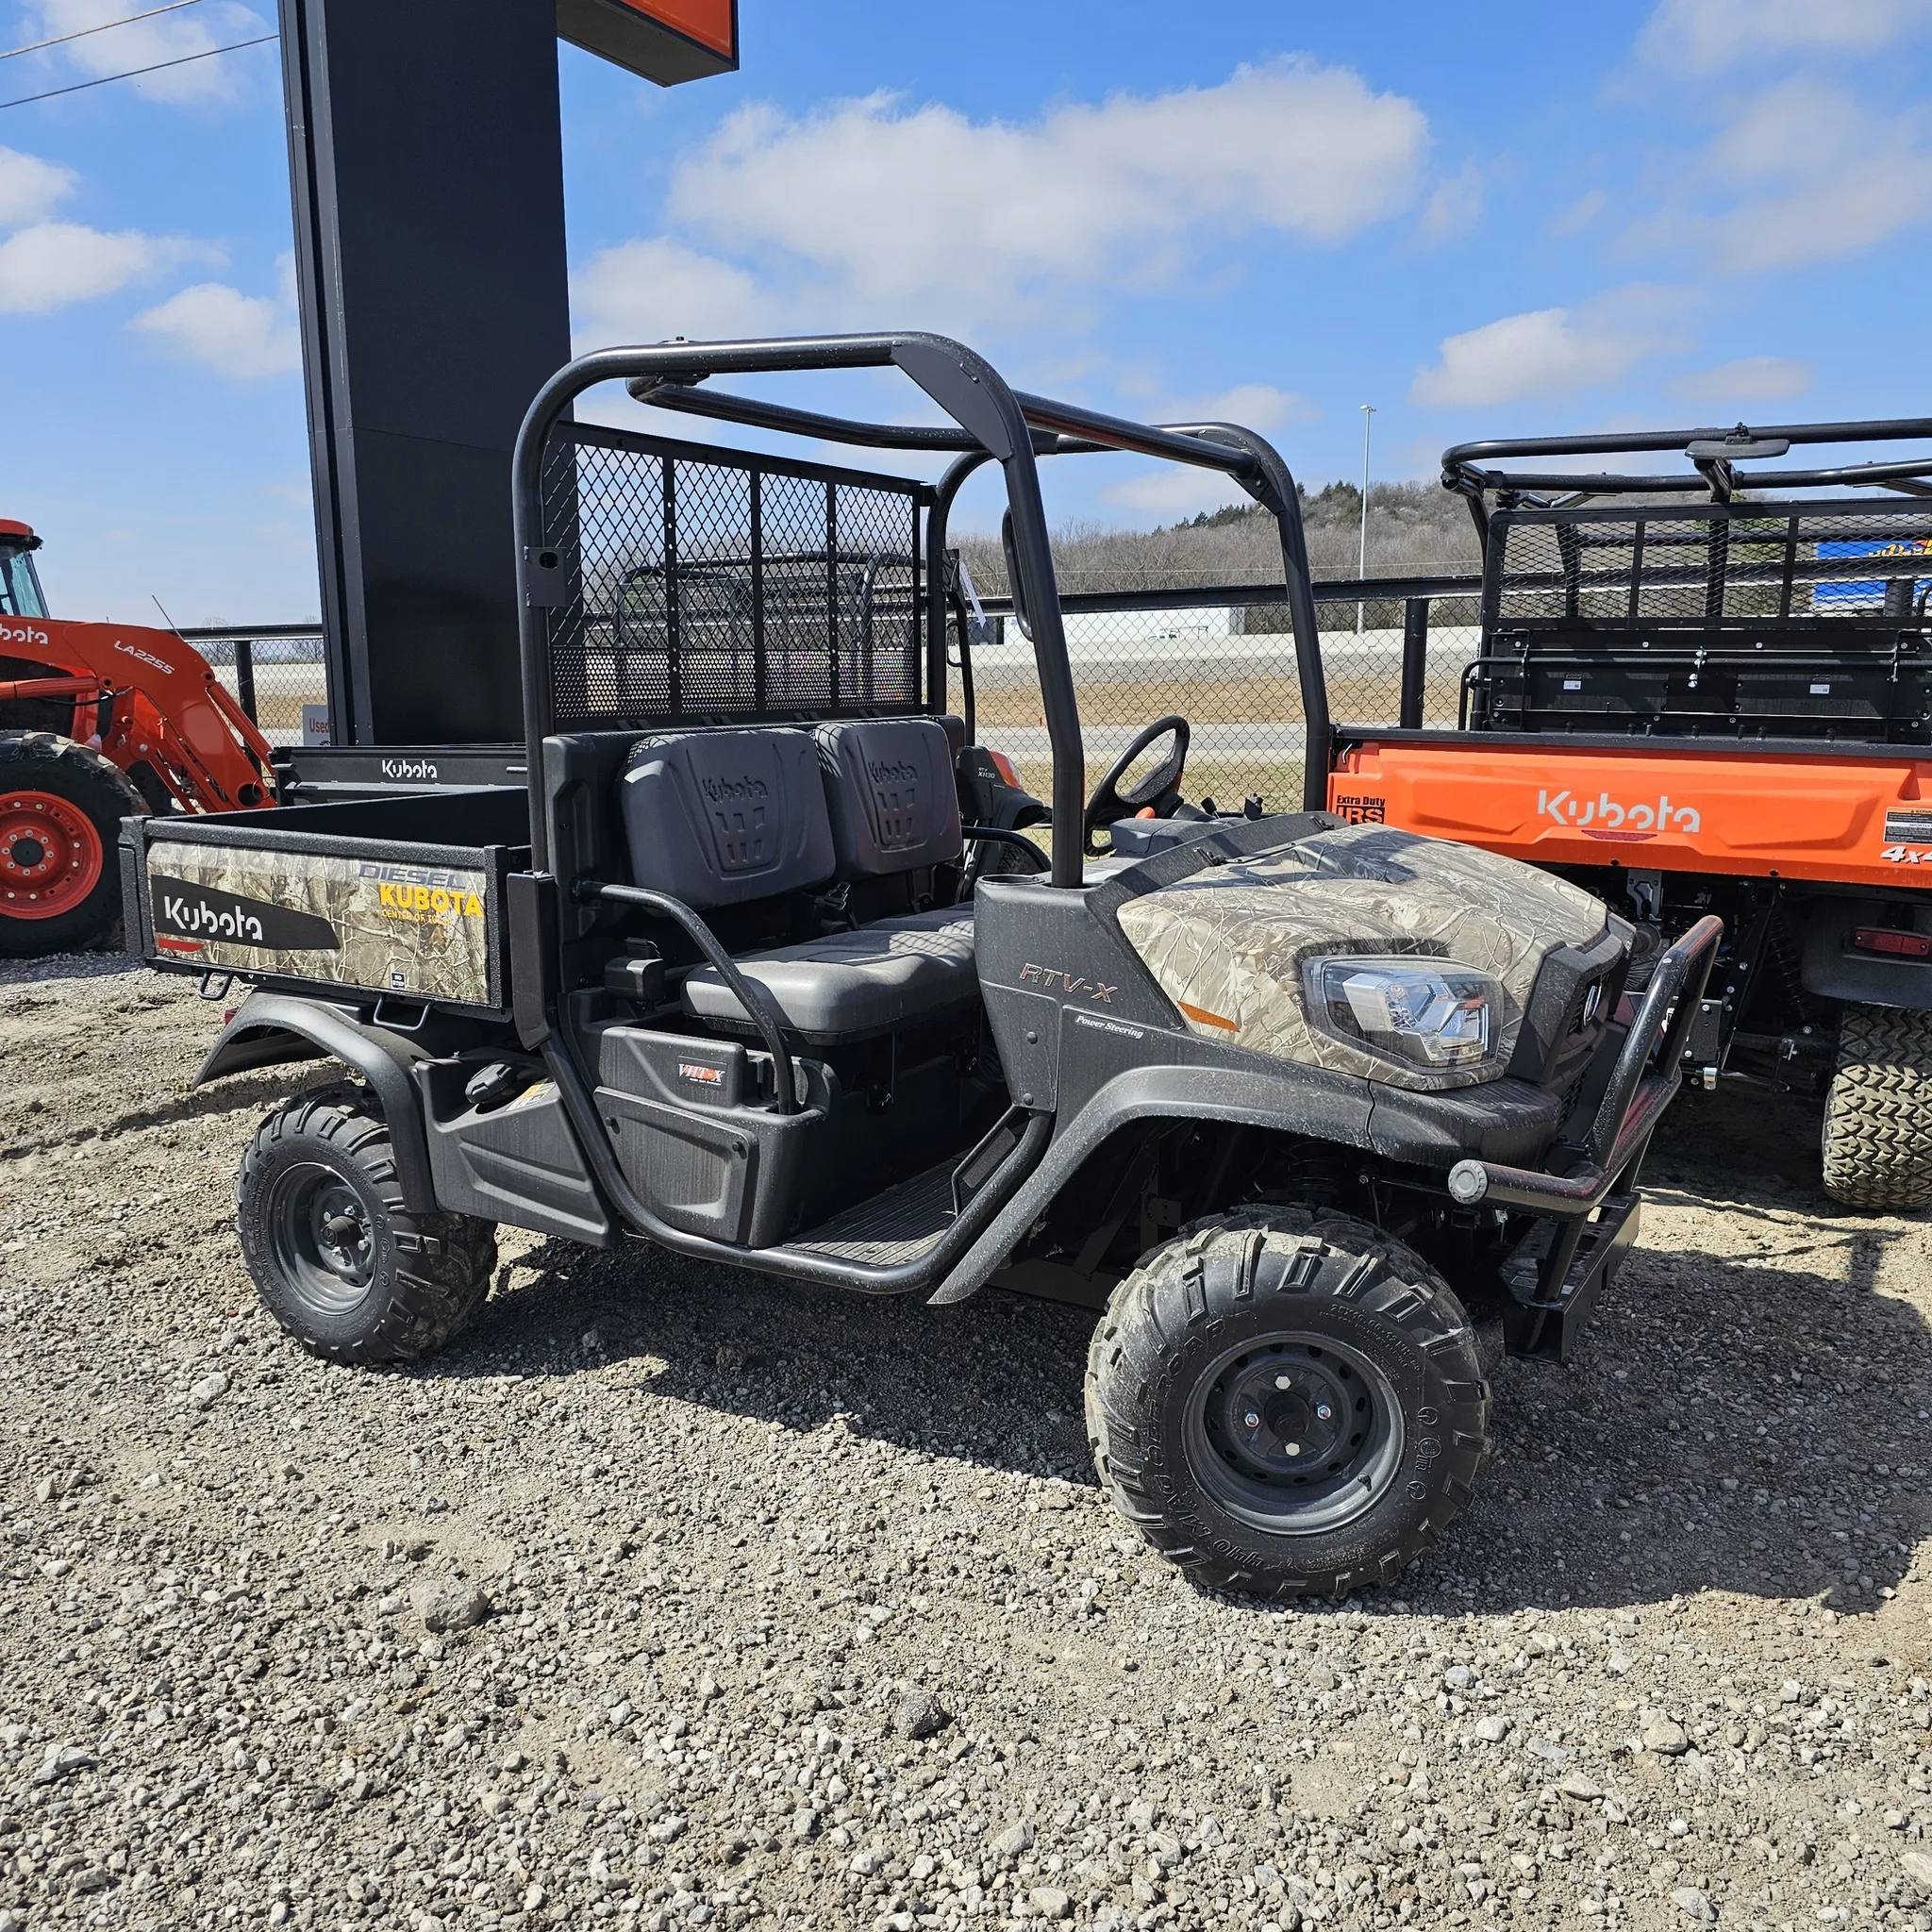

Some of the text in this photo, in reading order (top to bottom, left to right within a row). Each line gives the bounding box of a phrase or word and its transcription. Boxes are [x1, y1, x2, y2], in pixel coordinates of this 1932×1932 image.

[113, 640, 175, 675] LA2255
[308, 717, 330, 734] Used
[382, 759, 438, 779] Kubota
[868, 759, 918, 785] Kubota
[702, 774, 769, 803] Kubota
[1337, 795, 1386, 807] Extra Duty
[1538, 790, 1701, 833] Kubota
[359, 864, 467, 890] DIESEL
[379, 882, 483, 919] KUBOTA
[164, 895, 263, 941] Kubota
[1019, 962, 1119, 1004] RTV-X
[1075, 1015, 1144, 1040] Power Steering
